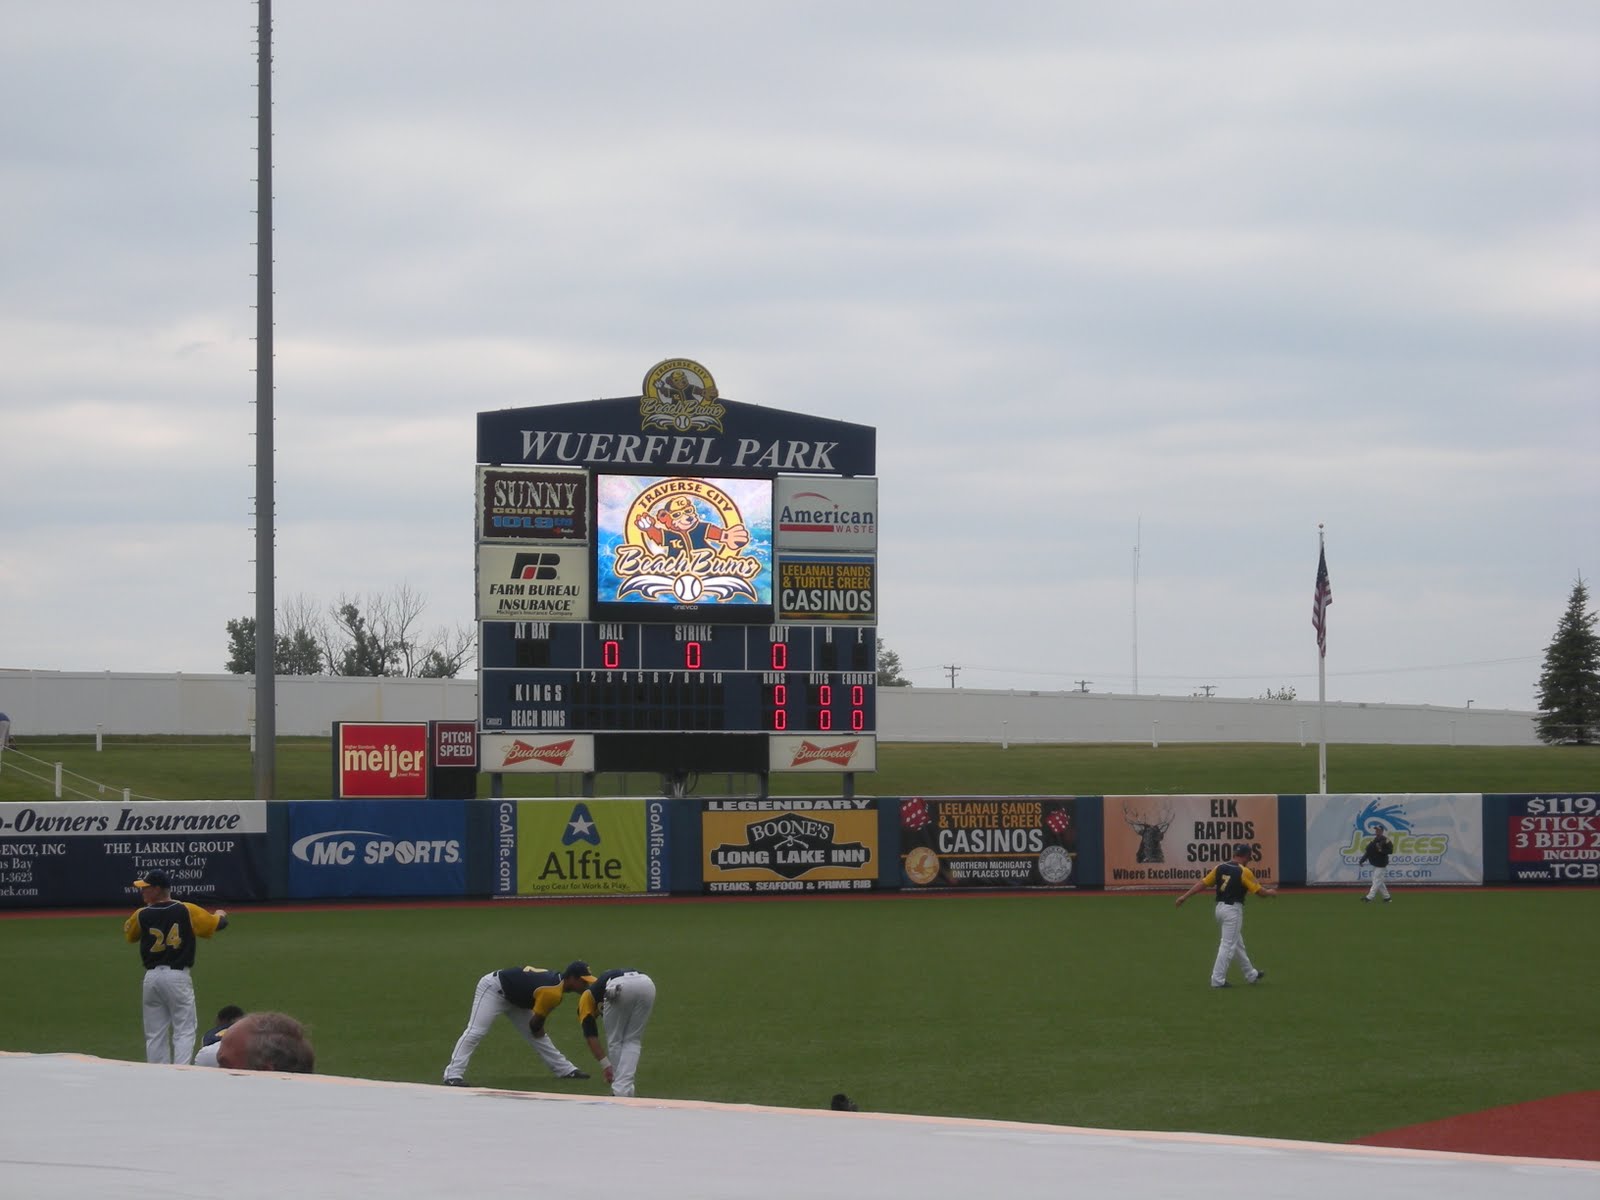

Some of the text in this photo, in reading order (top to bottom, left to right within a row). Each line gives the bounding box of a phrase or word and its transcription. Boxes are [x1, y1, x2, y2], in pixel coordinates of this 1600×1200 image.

[654, 361, 709, 380] TRAVERSE CITY
[642, 400, 683, 414] Beach
[520, 430, 839, 470] WUERFEL PARK
[494, 480, 578, 509] SUNNY
[638, 481, 733, 512] TRAVERSE CITY
[492, 508, 575, 516] COUNTRY
[780, 505, 874, 525] American
[492, 516, 553, 529] 101.9
[835, 525, 875, 534] WASTE
[669, 539, 684, 549] TC
[616, 548, 759, 576] Beach Bums
[783, 565, 871, 577] LEELANAU SANDS
[490, 584, 580, 597] FARM BUREAU
[783, 577, 871, 589] & TURTLE CREEK
[499, 599, 571, 611] INSURANCE
[782, 590, 872, 612] CASINOS
[514, 622, 550, 640] AT BAT
[599, 624, 624, 641] BALL
[675, 625, 713, 642] STRIKE
[769, 626, 790, 643] OUT
[858, 628, 864, 644] E
[604, 641, 619, 669] 0
[686, 642, 701, 669] 0
[772, 643, 787, 670] 0
[575, 671, 722, 684] 1 2 3 4 5 6 7 8 9 10
[763, 673, 786, 684] RUNS
[809, 673, 829, 685] HITS
[842, 673, 873, 685] ERRORS
[515, 684, 562, 701] KINGS
[774, 685, 786, 706] 0
[819, 685, 831, 706] 0
[852, 685, 863, 706] 0
[511, 710, 538, 727] BEACH
[541, 710, 566, 727] BUMS
[774, 709, 786, 730] 0
[819, 709, 831, 730] 0
[852, 709, 863, 730] 0
[441, 732, 472, 744] PITCH
[440, 745, 473, 757] SPEED
[502, 744, 574, 759] Budweiser
[790, 745, 857, 760] Budweiser
[344, 744, 424, 778] meijer
[708, 800, 870, 811] LEGENDARY
[939, 803, 1042, 815] LEELANAU SANDS
[1210, 799, 1238, 818] ELK
[115, 808, 240, 832] Insurance
[939, 815, 1043, 828] & TURTLE CREEK
[1520, 816, 1596, 832] STICK
[752, 820, 830, 842] BOONE'S
[1194, 821, 1255, 840] RAPIDS
[104, 841, 235, 854] THE LARKIN GROUP
[500, 802, 514, 891] GoAlfie.com
[650, 802, 665, 890] GoAlfie.com
[939, 829, 1043, 853] CASINOS
[1515, 832, 1600, 848] 3 BED 2
[0, 843, 66, 856] ENCY, INC
[312, 840, 460, 865] MC SPORTS
[718, 850, 865, 865] LONG LAKE INN
[1187, 843, 1262, 862] SCHOS
[12, 858, 33, 872] Bay
[132, 855, 208, 869] Traverse City
[538, 850, 622, 880] Alfie
[950, 860, 1032, 870] NORTHERN MICHIGAN'S
[1388, 855, 1412, 863] OGO
[1414, 855, 1439, 863] GEAR
[952, 870, 971, 878] ONLY
[972, 870, 999, 878] PLACES
[1011, 869, 1030, 877] PLAY
[1113, 867, 1145, 880] Where
[1148, 867, 1201, 880] Excellence
[1518, 863, 1600, 879] www.TCB
[532, 883, 550, 892] Logo
[570, 882, 580, 890] for
[756, 881, 803, 890] SEAFOOD
[806, 882, 815, 890] &
[817, 880, 851, 889] PRIME
[853, 880, 872, 889] RIB
[1221, 874, 1231, 893] 7
[150, 923, 182, 952] 24
